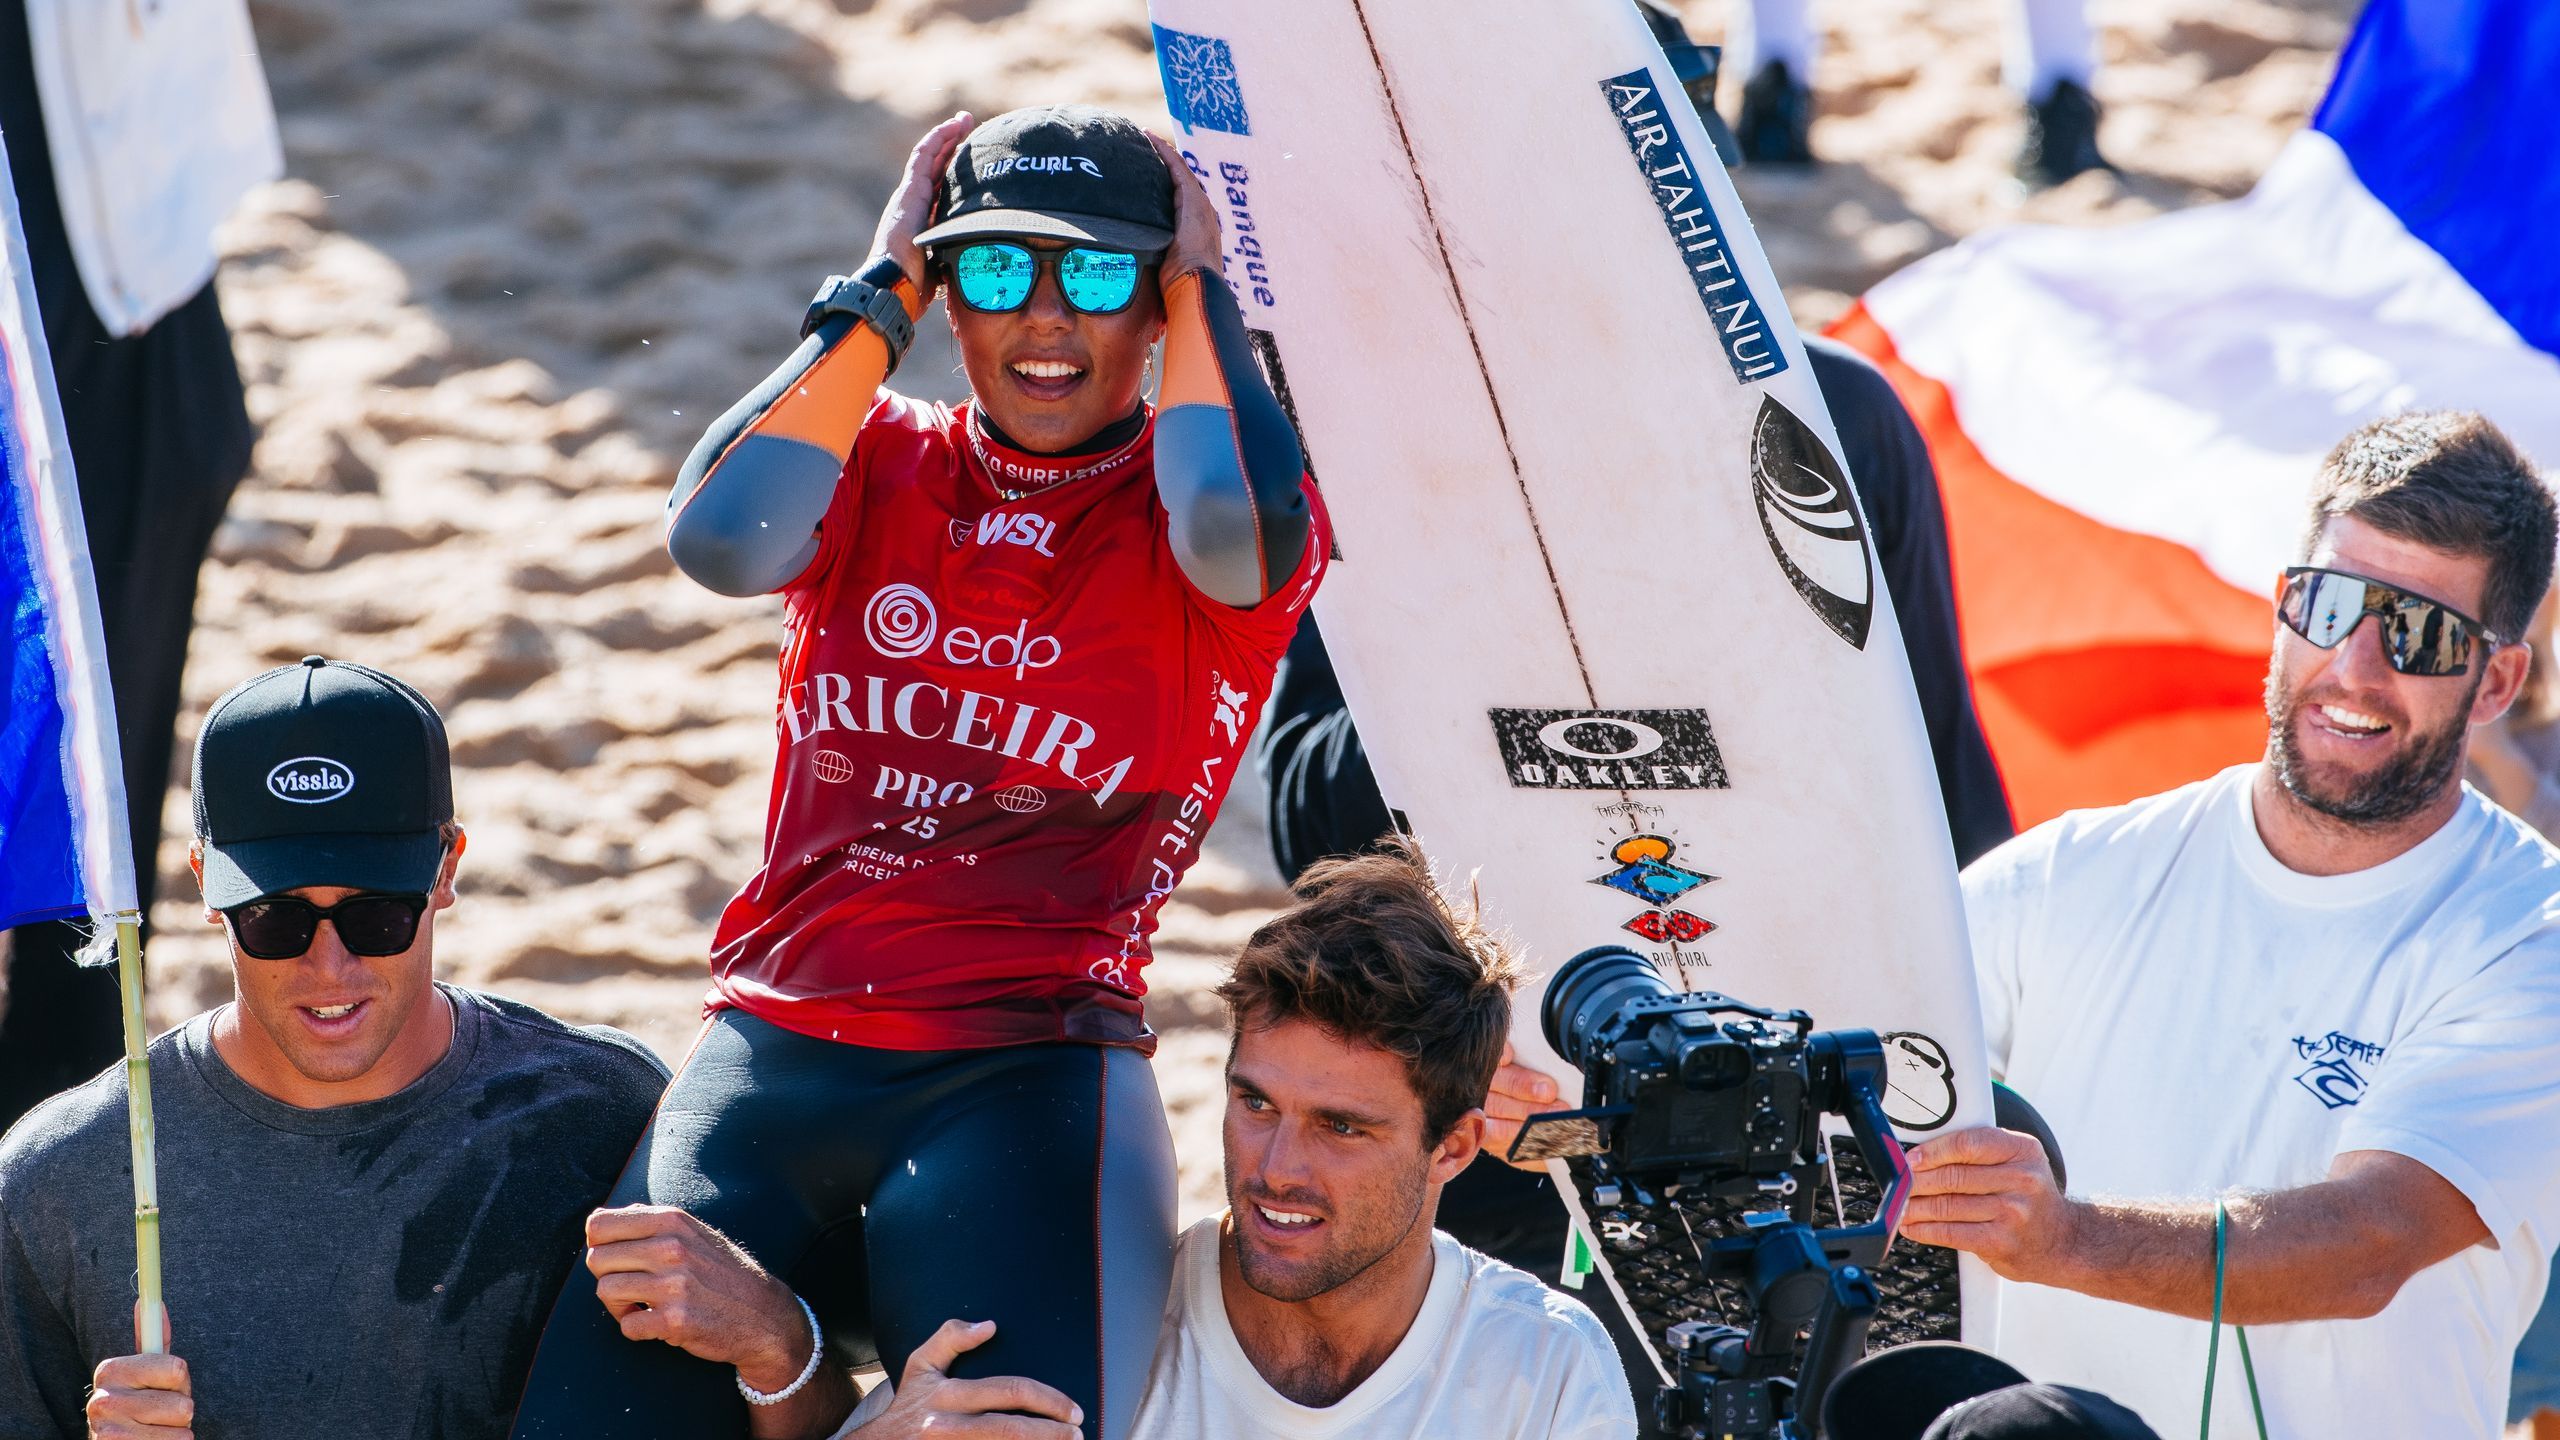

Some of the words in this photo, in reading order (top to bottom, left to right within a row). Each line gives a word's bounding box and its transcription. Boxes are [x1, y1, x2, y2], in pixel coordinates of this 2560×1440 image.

[1219, 161, 1276, 307] Banque
[1611, 83, 1669, 161] AIR
[1652, 152, 1737, 293] TAHITI
[1716, 299, 1776, 377] NUI
[1005, 463, 1060, 485] SURF
[976, 512, 1056, 557] WSL
[943, 618, 1062, 681] edp
[785, 672, 1135, 809] ERICEIRA
[275, 767, 344, 793] vissla
[1520, 764, 1702, 785] OAKLEY
[1160, 756, 1222, 855] visit
[848, 842, 906, 869] RIBEIRA
[1652, 951, 1673, 967] RIP
[1676, 951, 1713, 967] CURL
